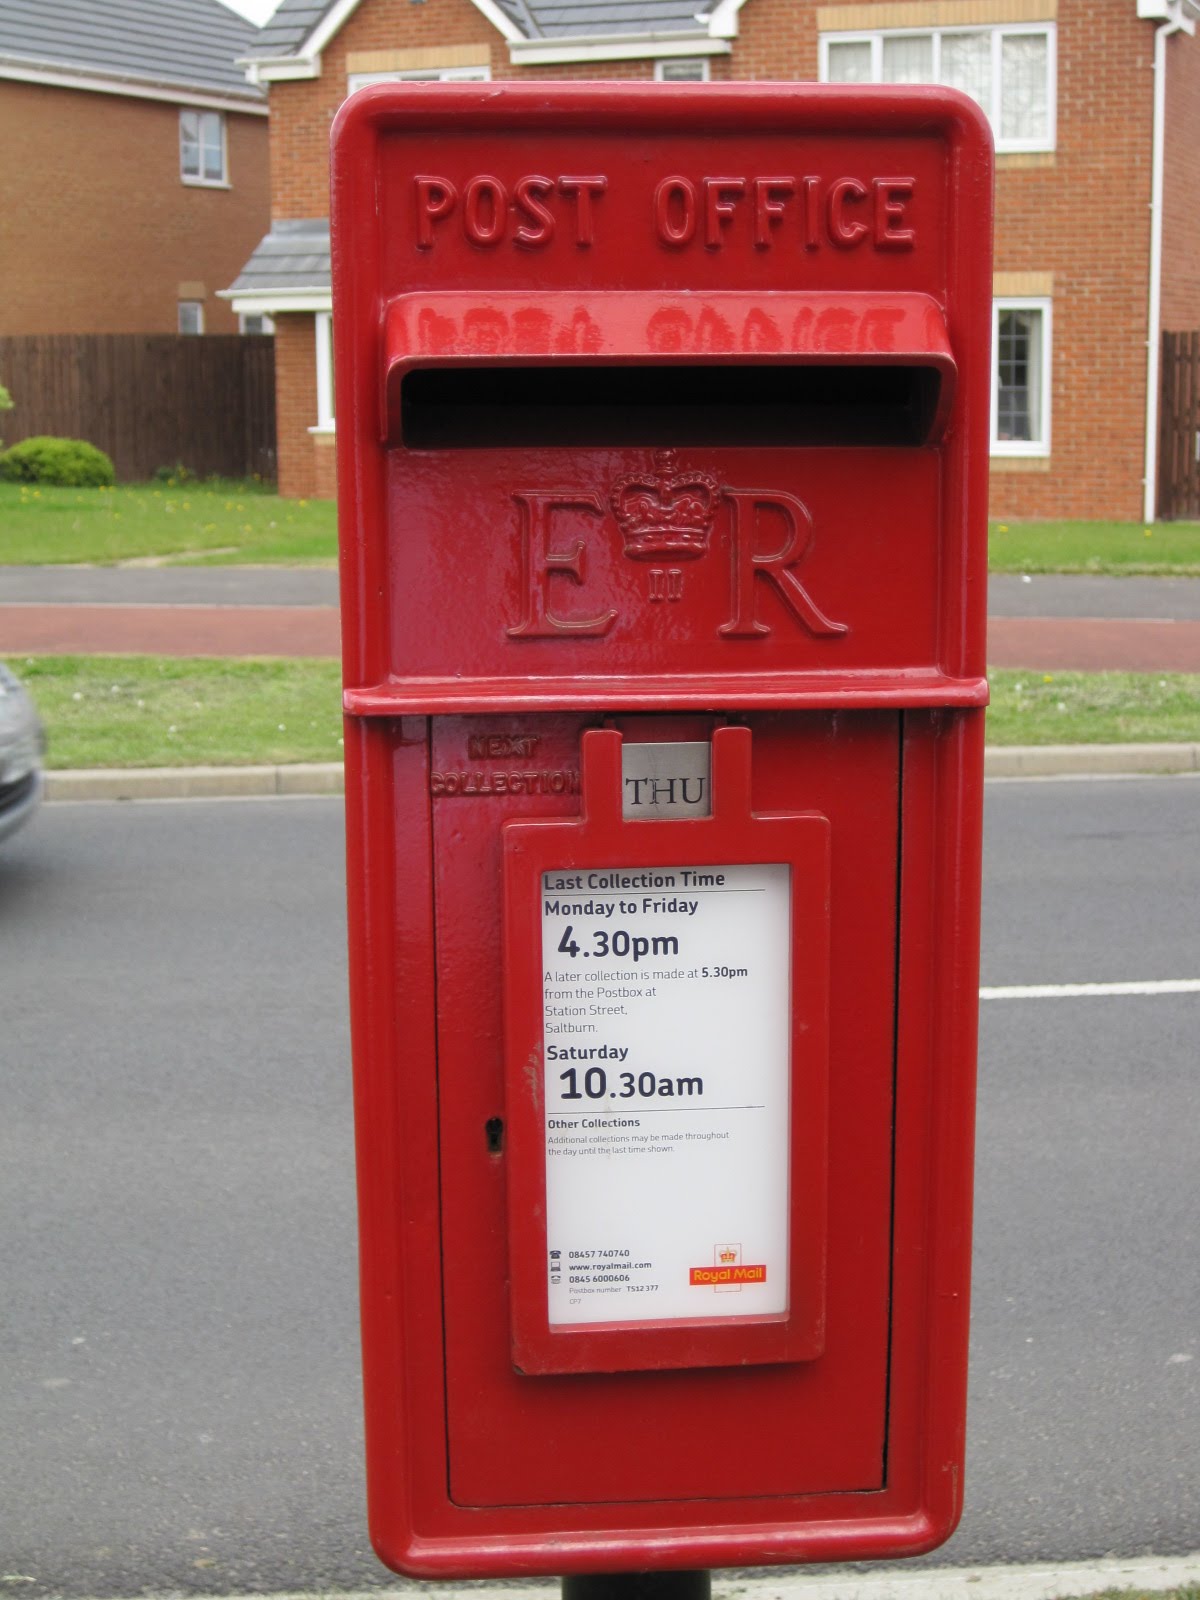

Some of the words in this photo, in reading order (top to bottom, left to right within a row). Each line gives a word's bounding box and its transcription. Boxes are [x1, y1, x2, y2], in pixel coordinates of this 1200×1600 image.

[414, 175, 607, 251] POST
[652, 175, 915, 251] OFFICE
[506, 488, 618, 639] E
[648, 568, 682, 601] II
[717, 487, 849, 639] R
[468, 735, 539, 760] NEXT
[430, 771, 580, 796] COLLECTION
[625, 777, 706, 805] THU
[544, 874, 583, 891] Last
[587, 873, 675, 889] Collection
[680, 871, 725, 887] Time
[545, 899, 615, 918] Monday
[619, 899, 637, 914] to
[642, 898, 699, 916] Friday
[557, 925, 679, 962] 4.30pm
[544, 971, 553, 982] A
[555, 971, 582, 982] later
[584, 970, 638, 981] collection
[640, 969, 650, 980] is
[652, 968, 685, 980] made
[687, 968, 699, 979] at
[701, 966, 748, 980] 5.30pm
[544, 988, 573, 999] from
[575, 987, 594, 999] the
[597, 987, 643, 998] Postbox
[645, 986, 657, 997] at
[545, 1005, 586, 1016] Station
[589, 1004, 628, 1016] Street,
[545, 1022, 598, 1034] Saltburn.
[547, 1044, 629, 1062] Saturday
[560, 1066, 704, 1100] 10.30am
[548, 1119, 579, 1129] Other
[581, 1118, 641, 1128] Collections
[547, 1135, 587, 1144] Additional
[589, 1134, 630, 1144] collections
[631, 1134, 649, 1144] may
[650, 1133, 660, 1142] be
[661, 1133, 684, 1142] made
[685, 1131, 730, 1142] throughout
[547, 1148, 562, 1156] the
[563, 1147, 577, 1157] day
[578, 1146, 596, 1155] until
[598, 1146, 611, 1155] the
[612, 1145, 627, 1154] last
[628, 1145, 646, 1154] time
[647, 1144, 675, 1153] shown.
[568, 1250, 596, 1259] 08457
[598, 1249, 630, 1258] 740740
[568, 1261, 652, 1272] www.royalmail.com
[693, 1267, 731, 1283] Royal
[733, 1266, 763, 1280] Mail
[568, 1275, 591, 1283] 0845
[592, 1274, 630, 1283] 6000606
[596, 1286, 622, 1294] number
[646, 1284, 659, 1292] 377
